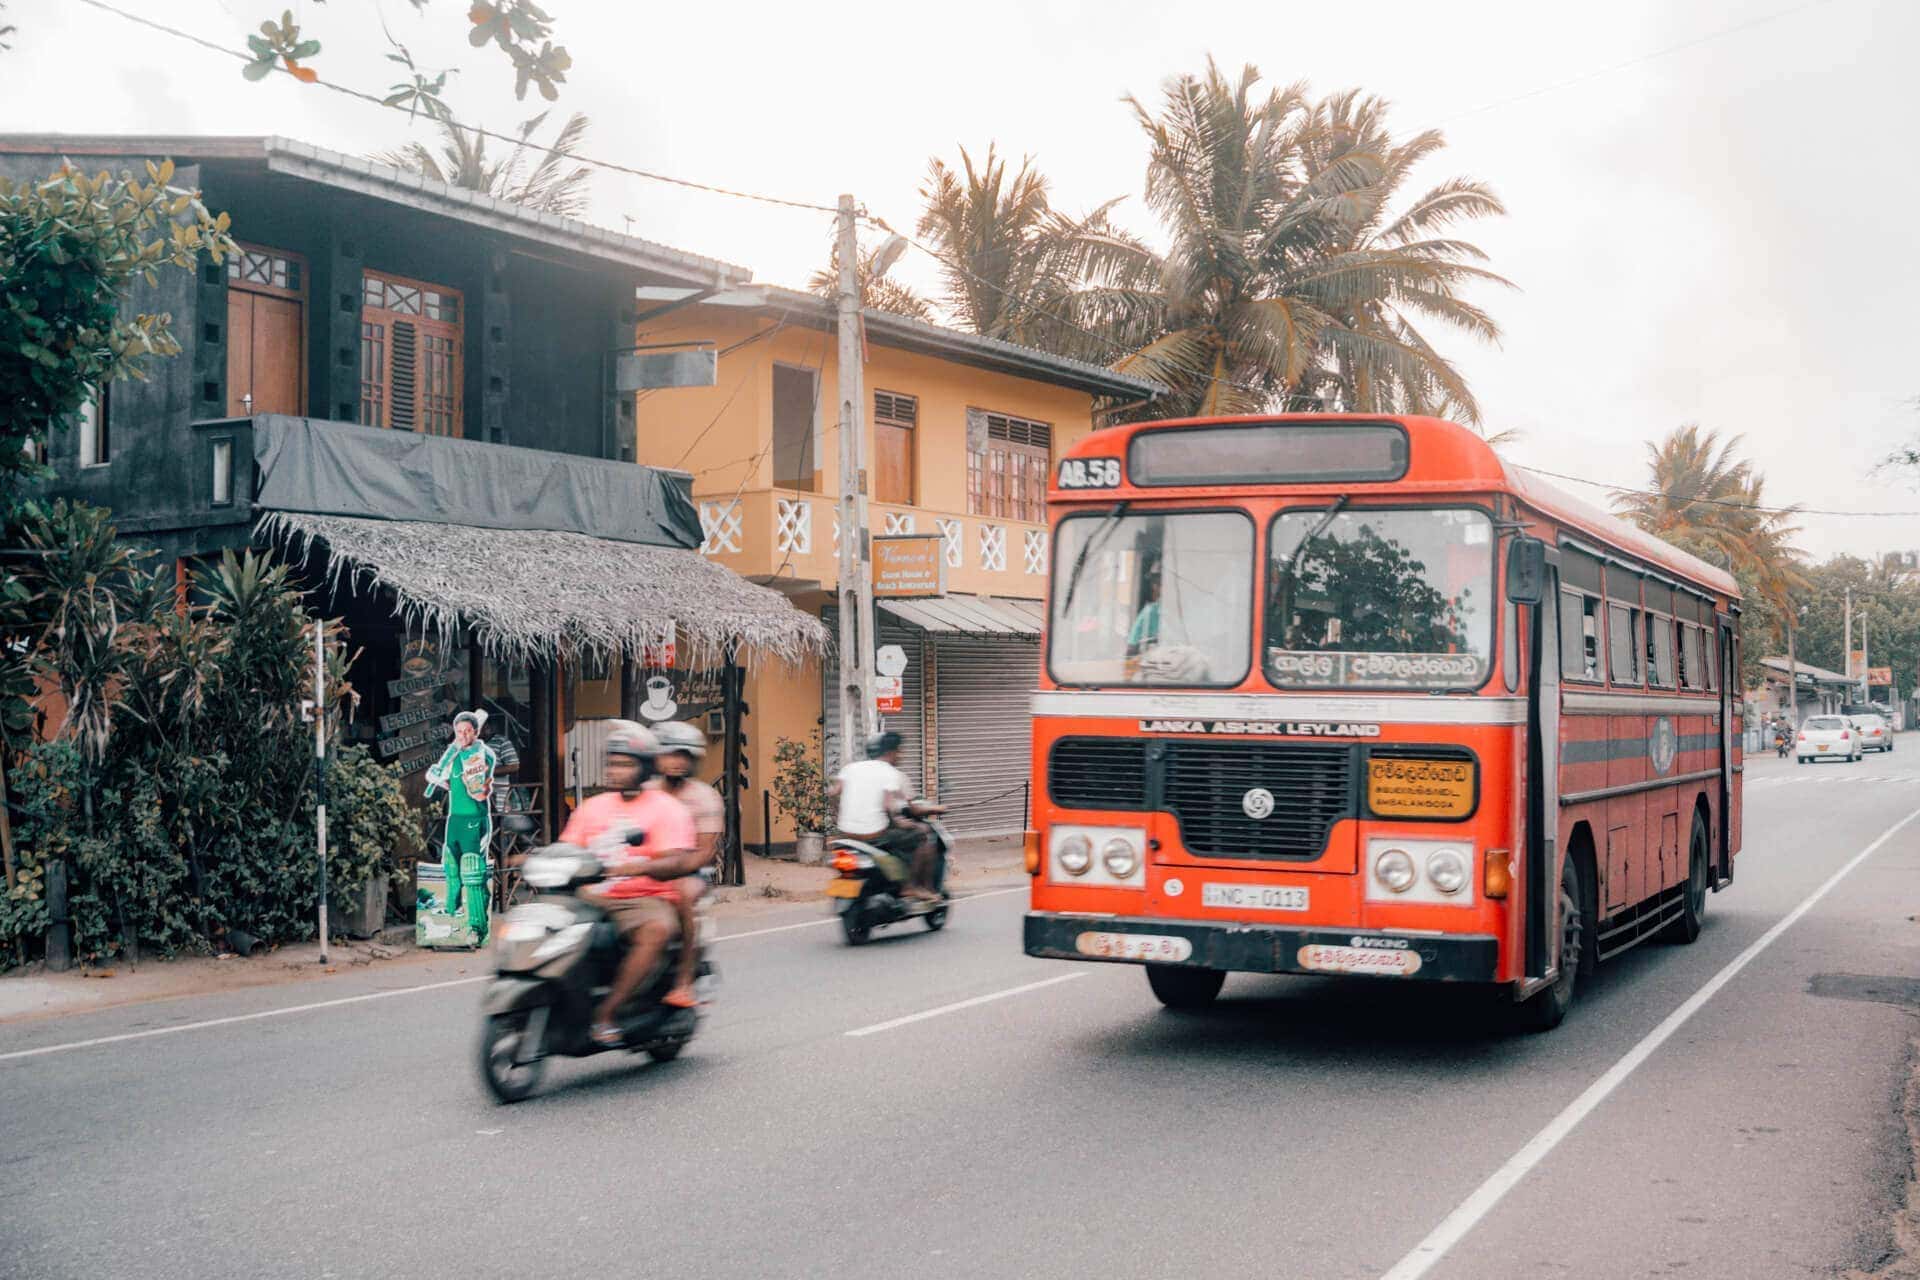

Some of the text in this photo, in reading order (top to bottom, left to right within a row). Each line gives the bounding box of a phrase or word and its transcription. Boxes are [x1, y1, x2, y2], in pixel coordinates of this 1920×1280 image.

[1138, 719, 1380, 738] LANKA ASHOK LEYLAND
